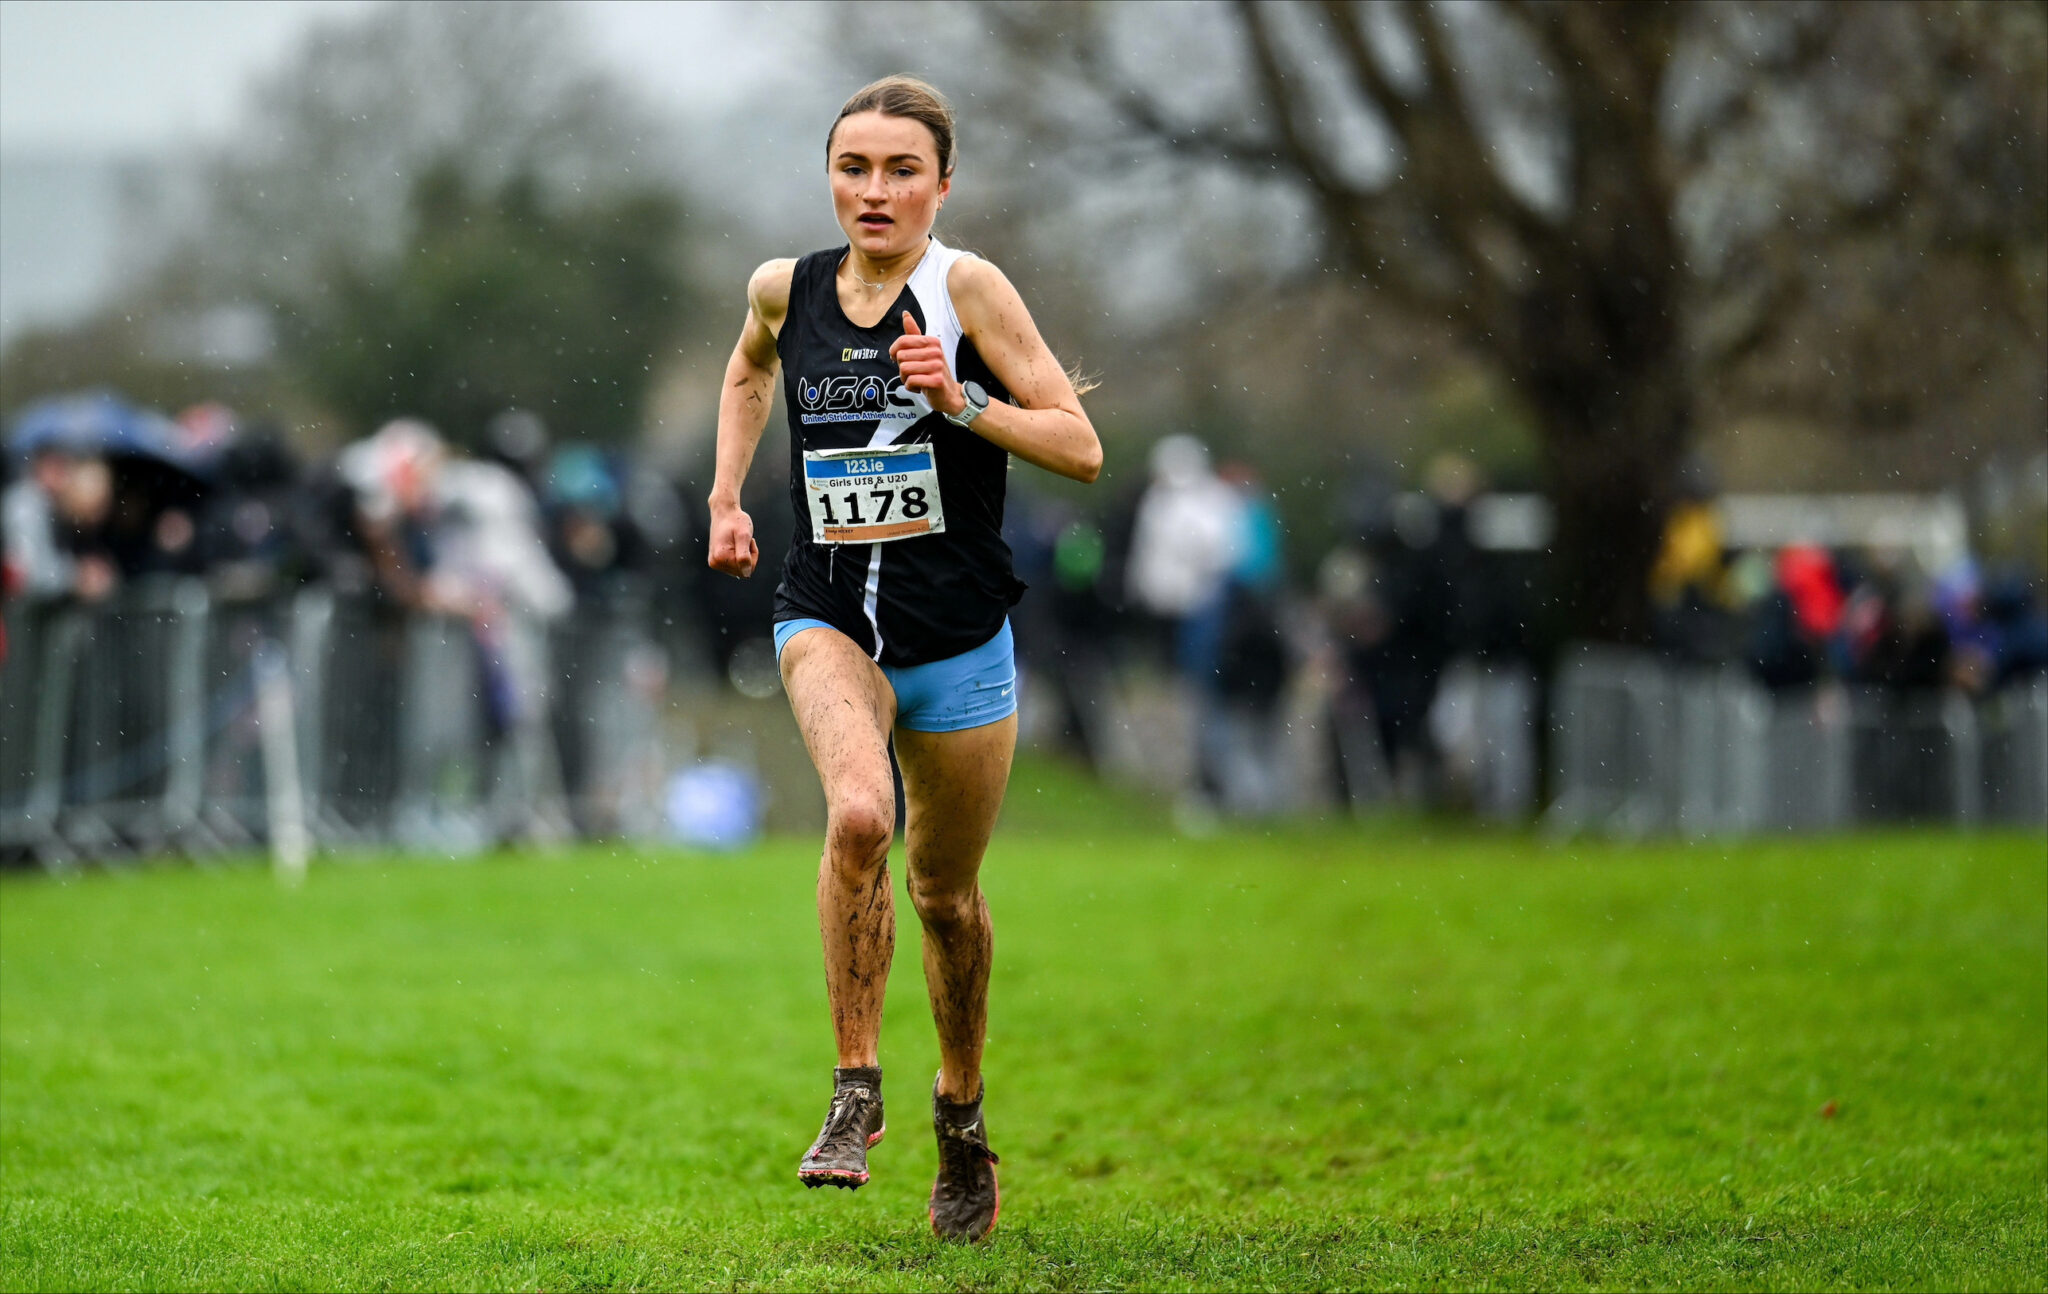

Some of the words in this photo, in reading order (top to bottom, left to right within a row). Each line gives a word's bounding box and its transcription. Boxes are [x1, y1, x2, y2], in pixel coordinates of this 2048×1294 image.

[798, 375, 915, 411] USAC
[802, 413, 827, 424] United
[827, 411, 860, 422] Striders
[861, 410, 896, 421] Athletics
[897, 411, 917, 420] Club
[844, 459, 885, 474] 123.ie
[829, 478, 852, 488] Girls
[854, 477, 874, 486] U18
[876, 475, 885, 484] &
[887, 474, 908, 483] U20
[818, 486, 929, 525] 1178
